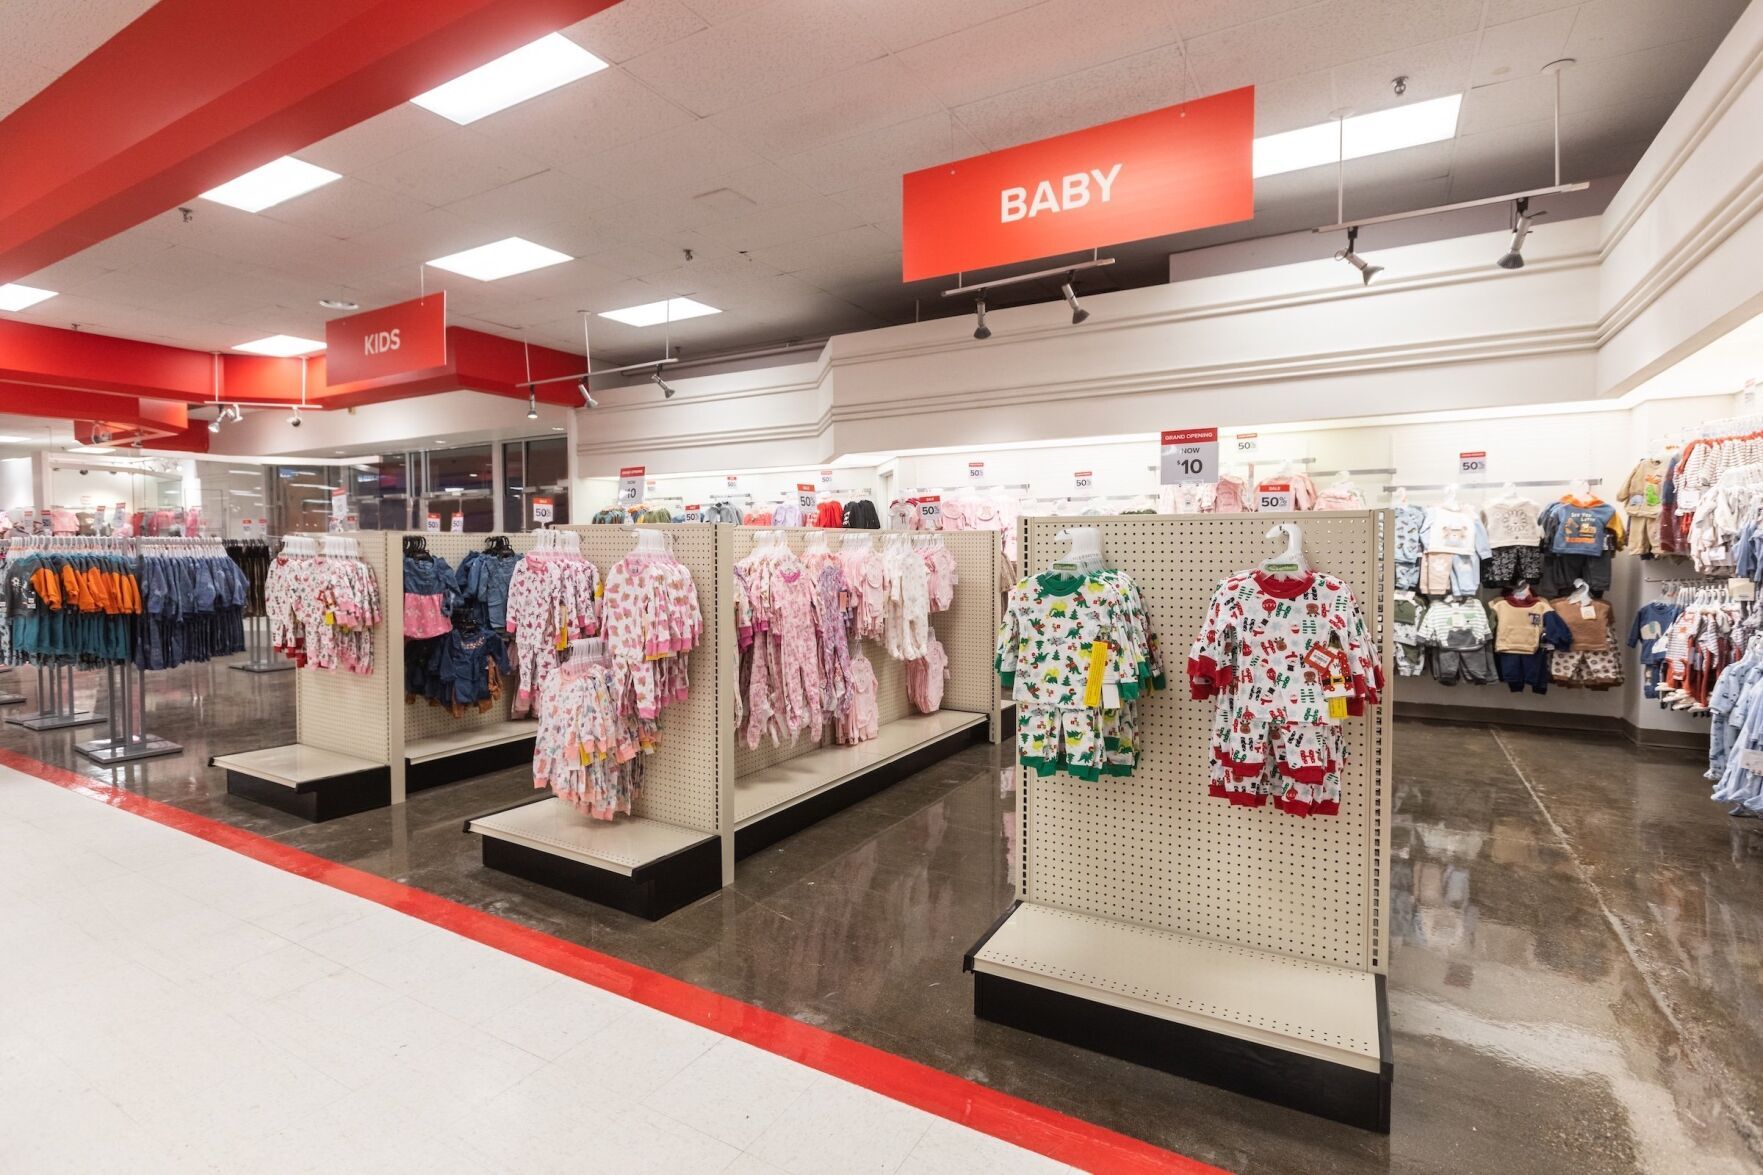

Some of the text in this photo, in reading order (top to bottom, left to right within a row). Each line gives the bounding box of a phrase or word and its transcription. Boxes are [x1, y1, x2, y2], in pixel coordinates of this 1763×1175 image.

[1001, 163, 1123, 224] BABY
[364, 328, 400, 356] KIDS
[1177, 459, 1203, 475] $10
